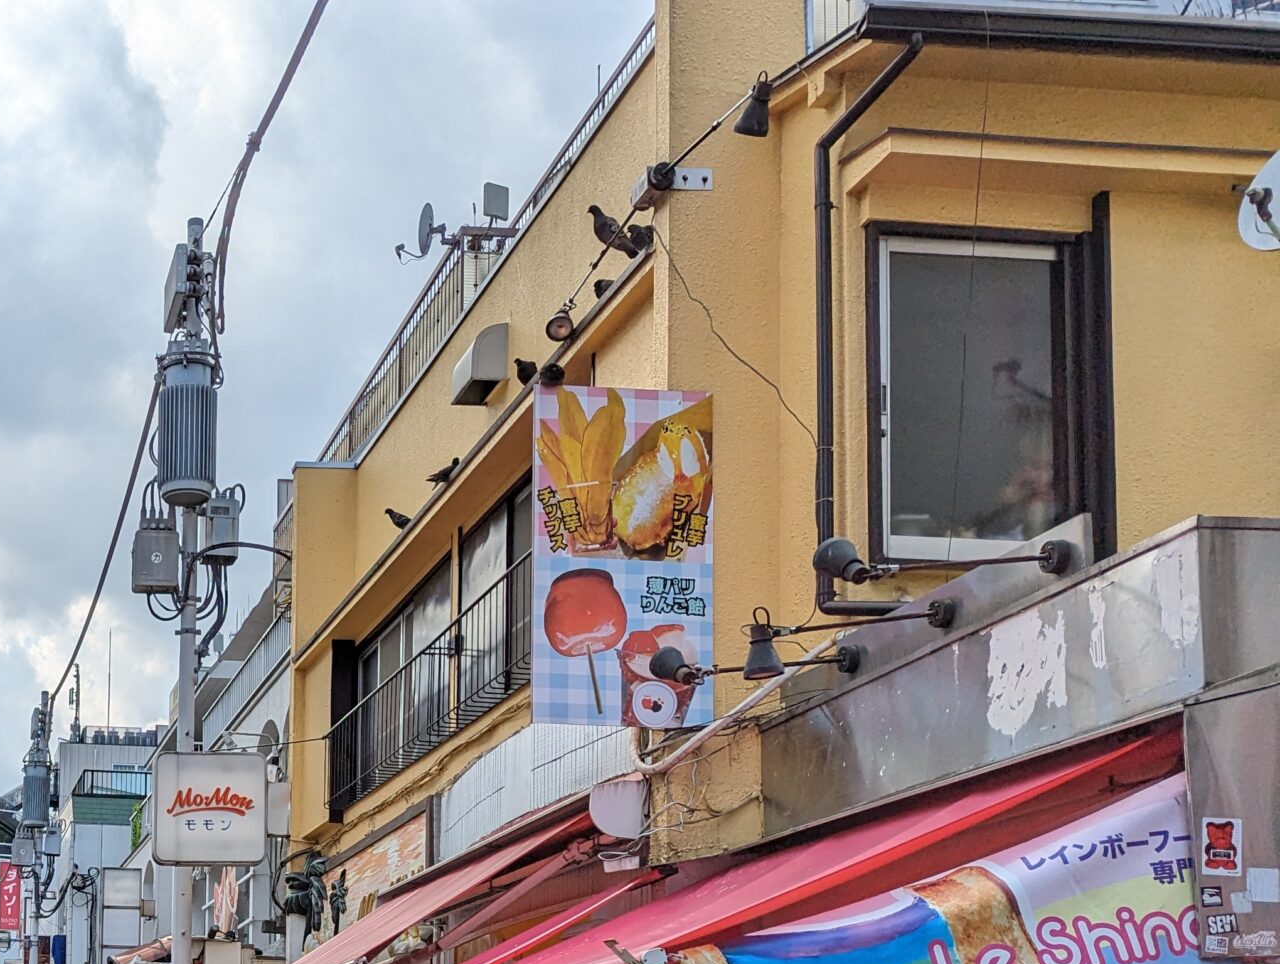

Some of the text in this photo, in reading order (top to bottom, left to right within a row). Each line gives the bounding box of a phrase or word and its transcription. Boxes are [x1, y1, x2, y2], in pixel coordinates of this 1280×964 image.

[537, 486, 568, 552] チップス
[558, 498, 582, 533] 蜜芋
[666, 494, 693, 559] ブリュレ
[685, 513, 708, 547] 蜜芋
[646, 576, 695, 596] 薄パリ
[640, 595, 706, 617] りんご飴
[184, 819, 232, 831] モモン
